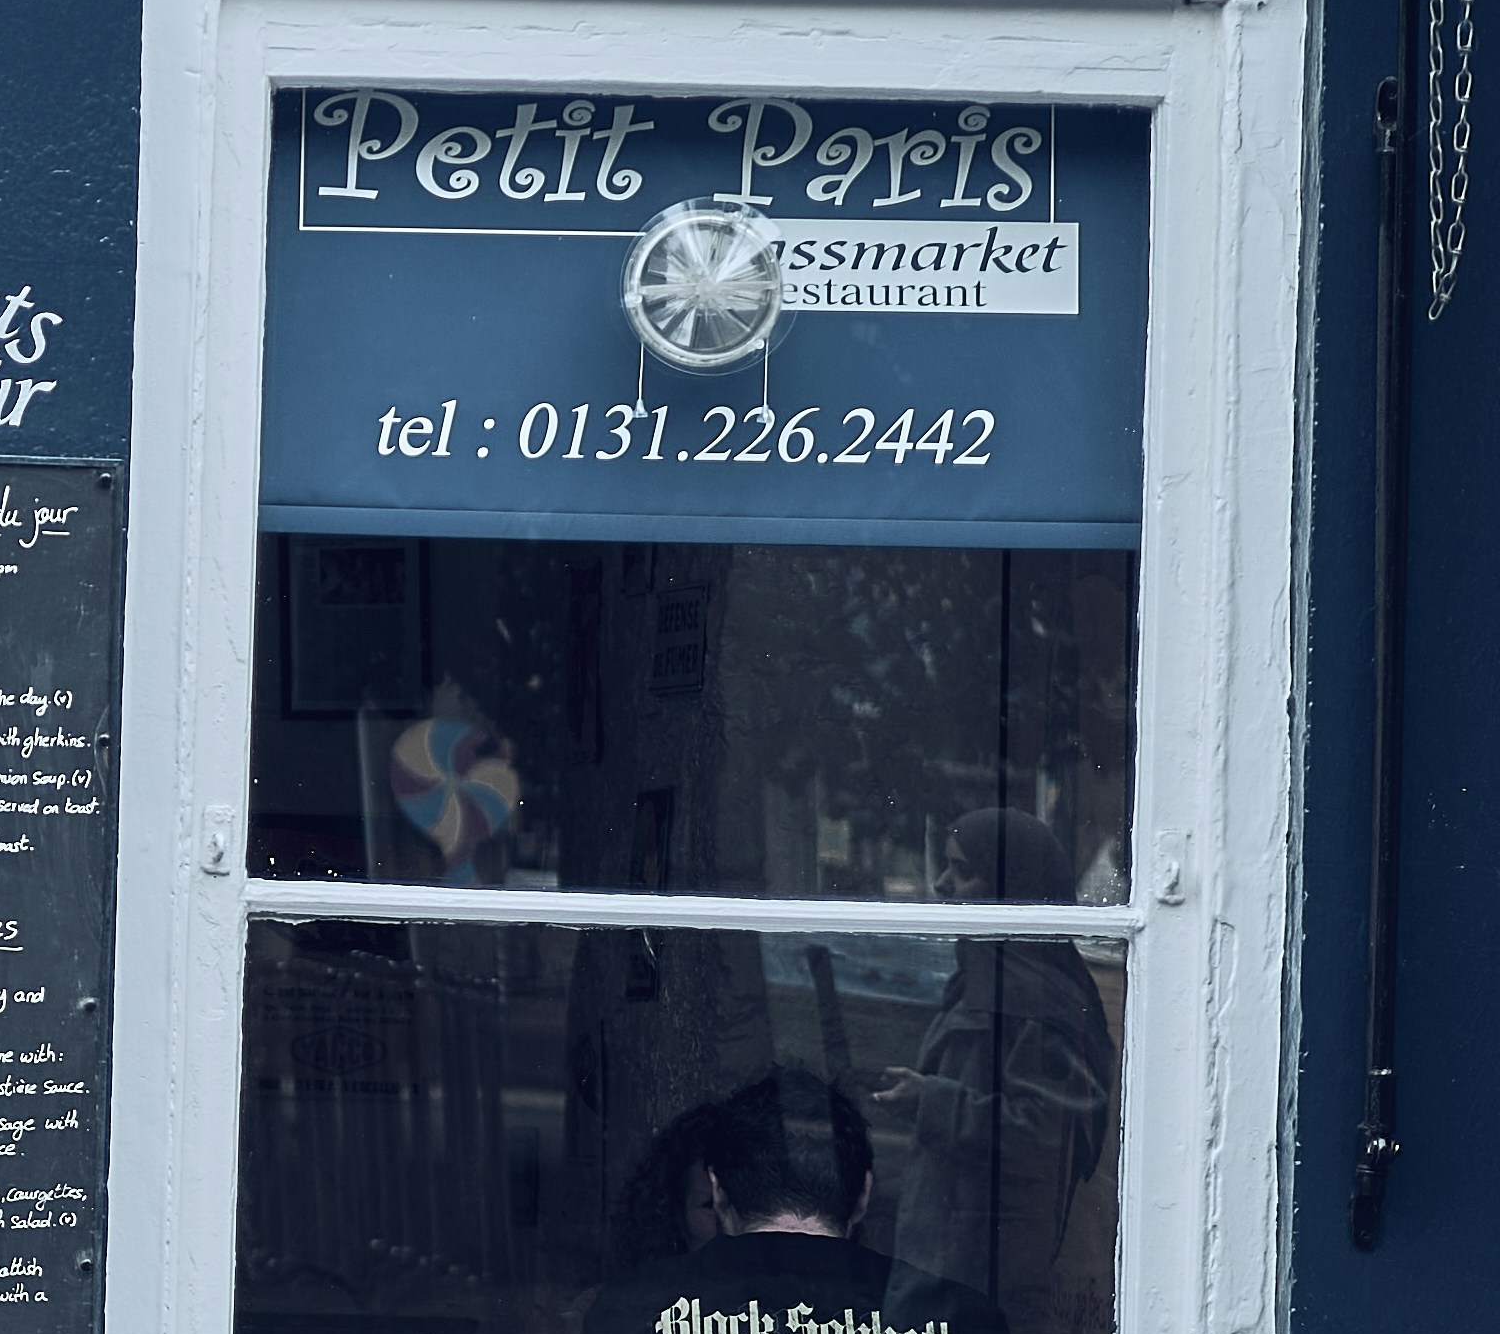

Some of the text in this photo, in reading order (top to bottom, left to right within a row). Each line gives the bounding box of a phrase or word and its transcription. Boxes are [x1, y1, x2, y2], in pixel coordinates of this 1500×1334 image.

[311, 87, 1043, 213] Petit Paris
[780, 277, 989, 310] estaurant
[376, 398, 996, 469] tel 0131.226.2442
[18, 497, 79, 548] jour
[14, 986, 45, 1004] and
[45, 1109, 79, 1130] with
